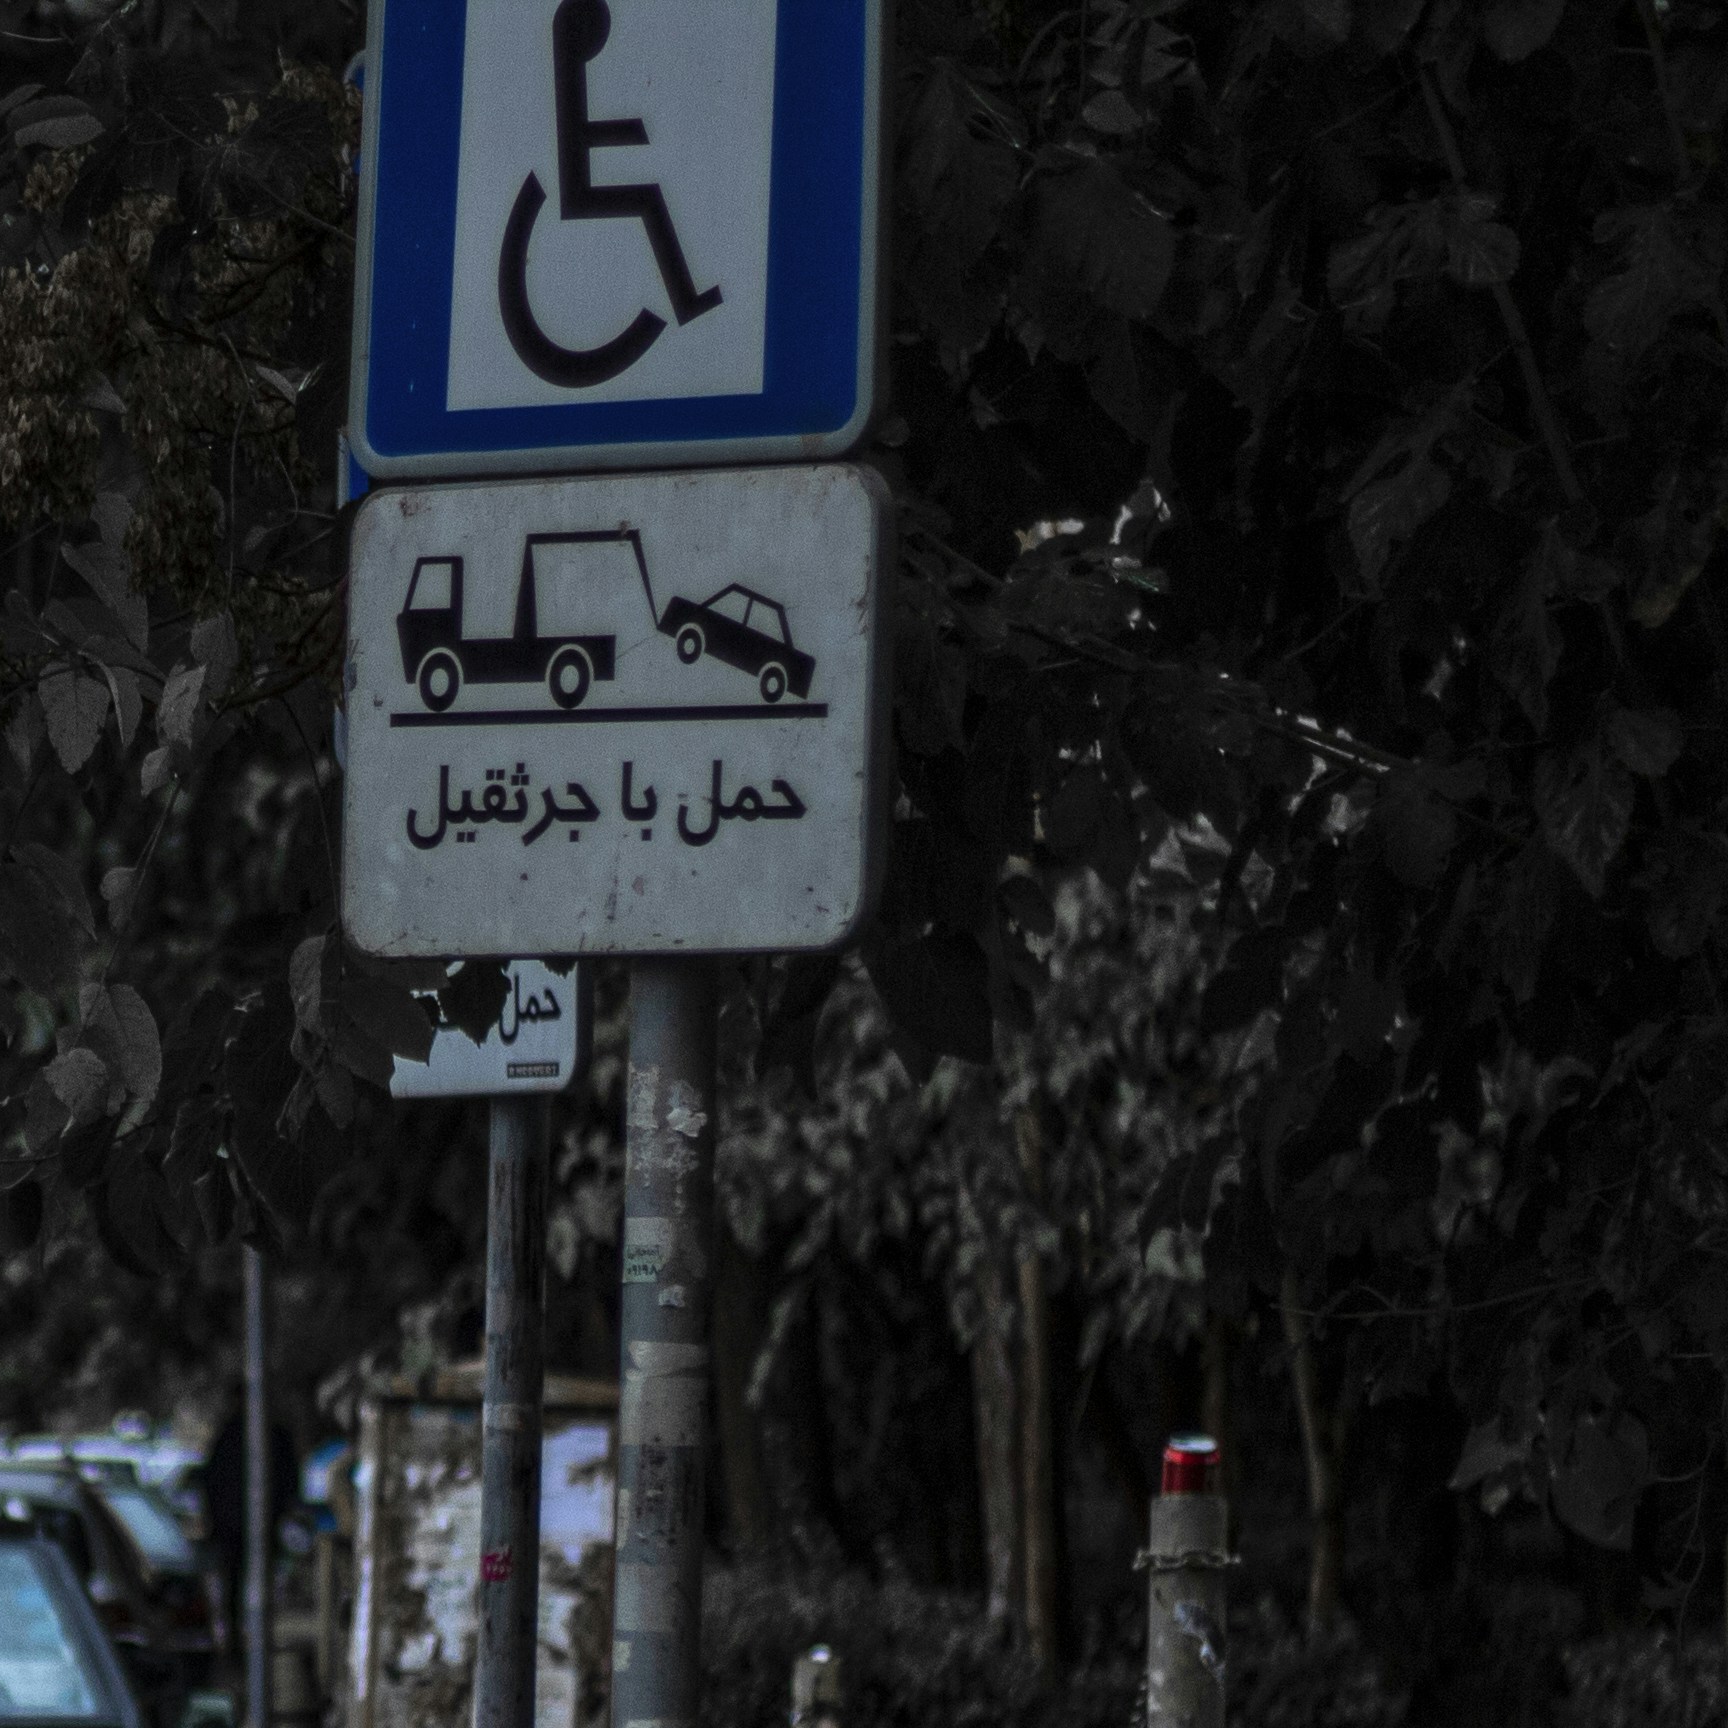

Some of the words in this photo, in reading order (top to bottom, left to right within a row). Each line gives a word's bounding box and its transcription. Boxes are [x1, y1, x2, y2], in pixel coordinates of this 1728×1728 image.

[406, 762, 601, 851] جرثقیل
[621, 761, 658, 842] با
[677, 759, 808, 847] حمل
[498, 973, 562, 1046] حمل
